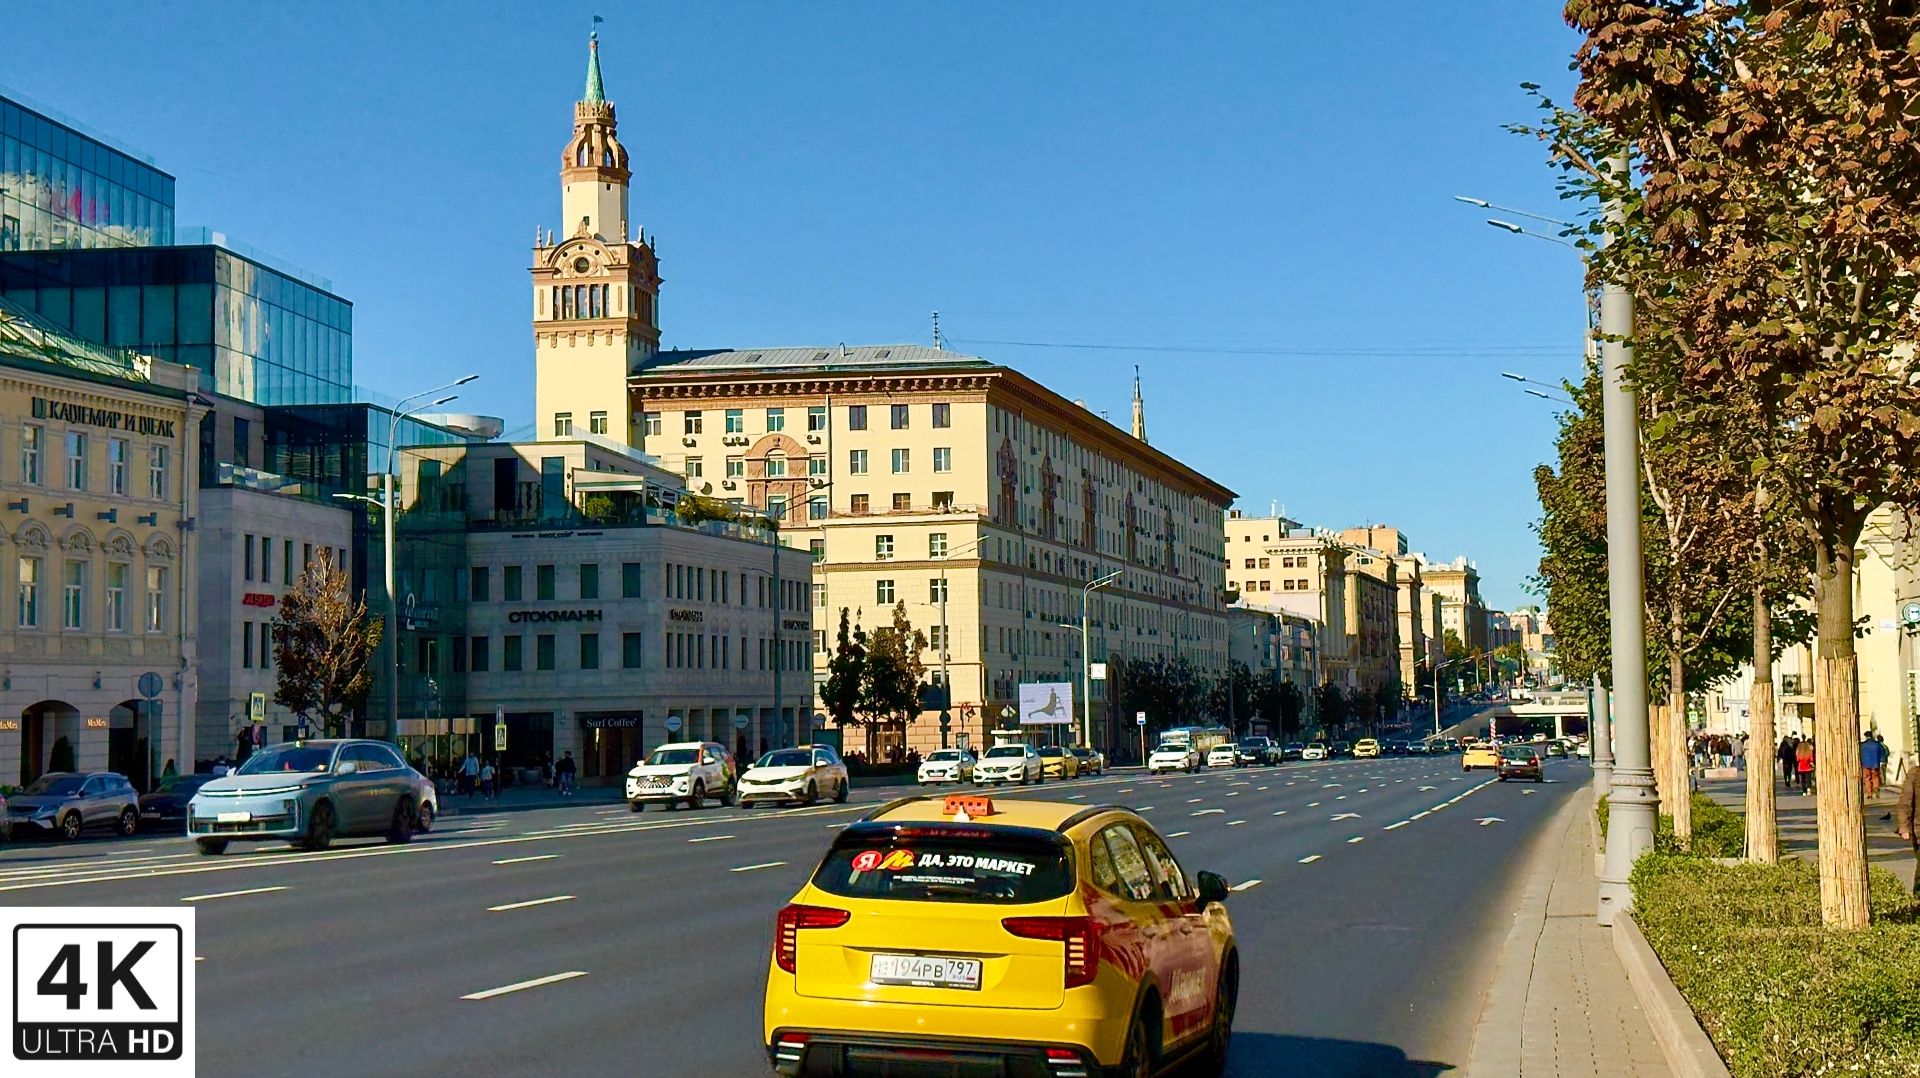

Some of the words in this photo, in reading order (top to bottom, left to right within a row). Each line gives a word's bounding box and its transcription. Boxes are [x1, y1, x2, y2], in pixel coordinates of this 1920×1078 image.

[50, 401, 121, 429] КАШЕМИР
[125, 414, 136, 431] И
[508, 609, 602, 623] СТОКМАНН
[586, 718, 607, 728] Surf
[918, 854, 945, 868] ДА,
[946, 855, 974, 867] ЭТО
[974, 857, 1036, 876] МАРКЕТ
[948, 960, 974, 976] 797
